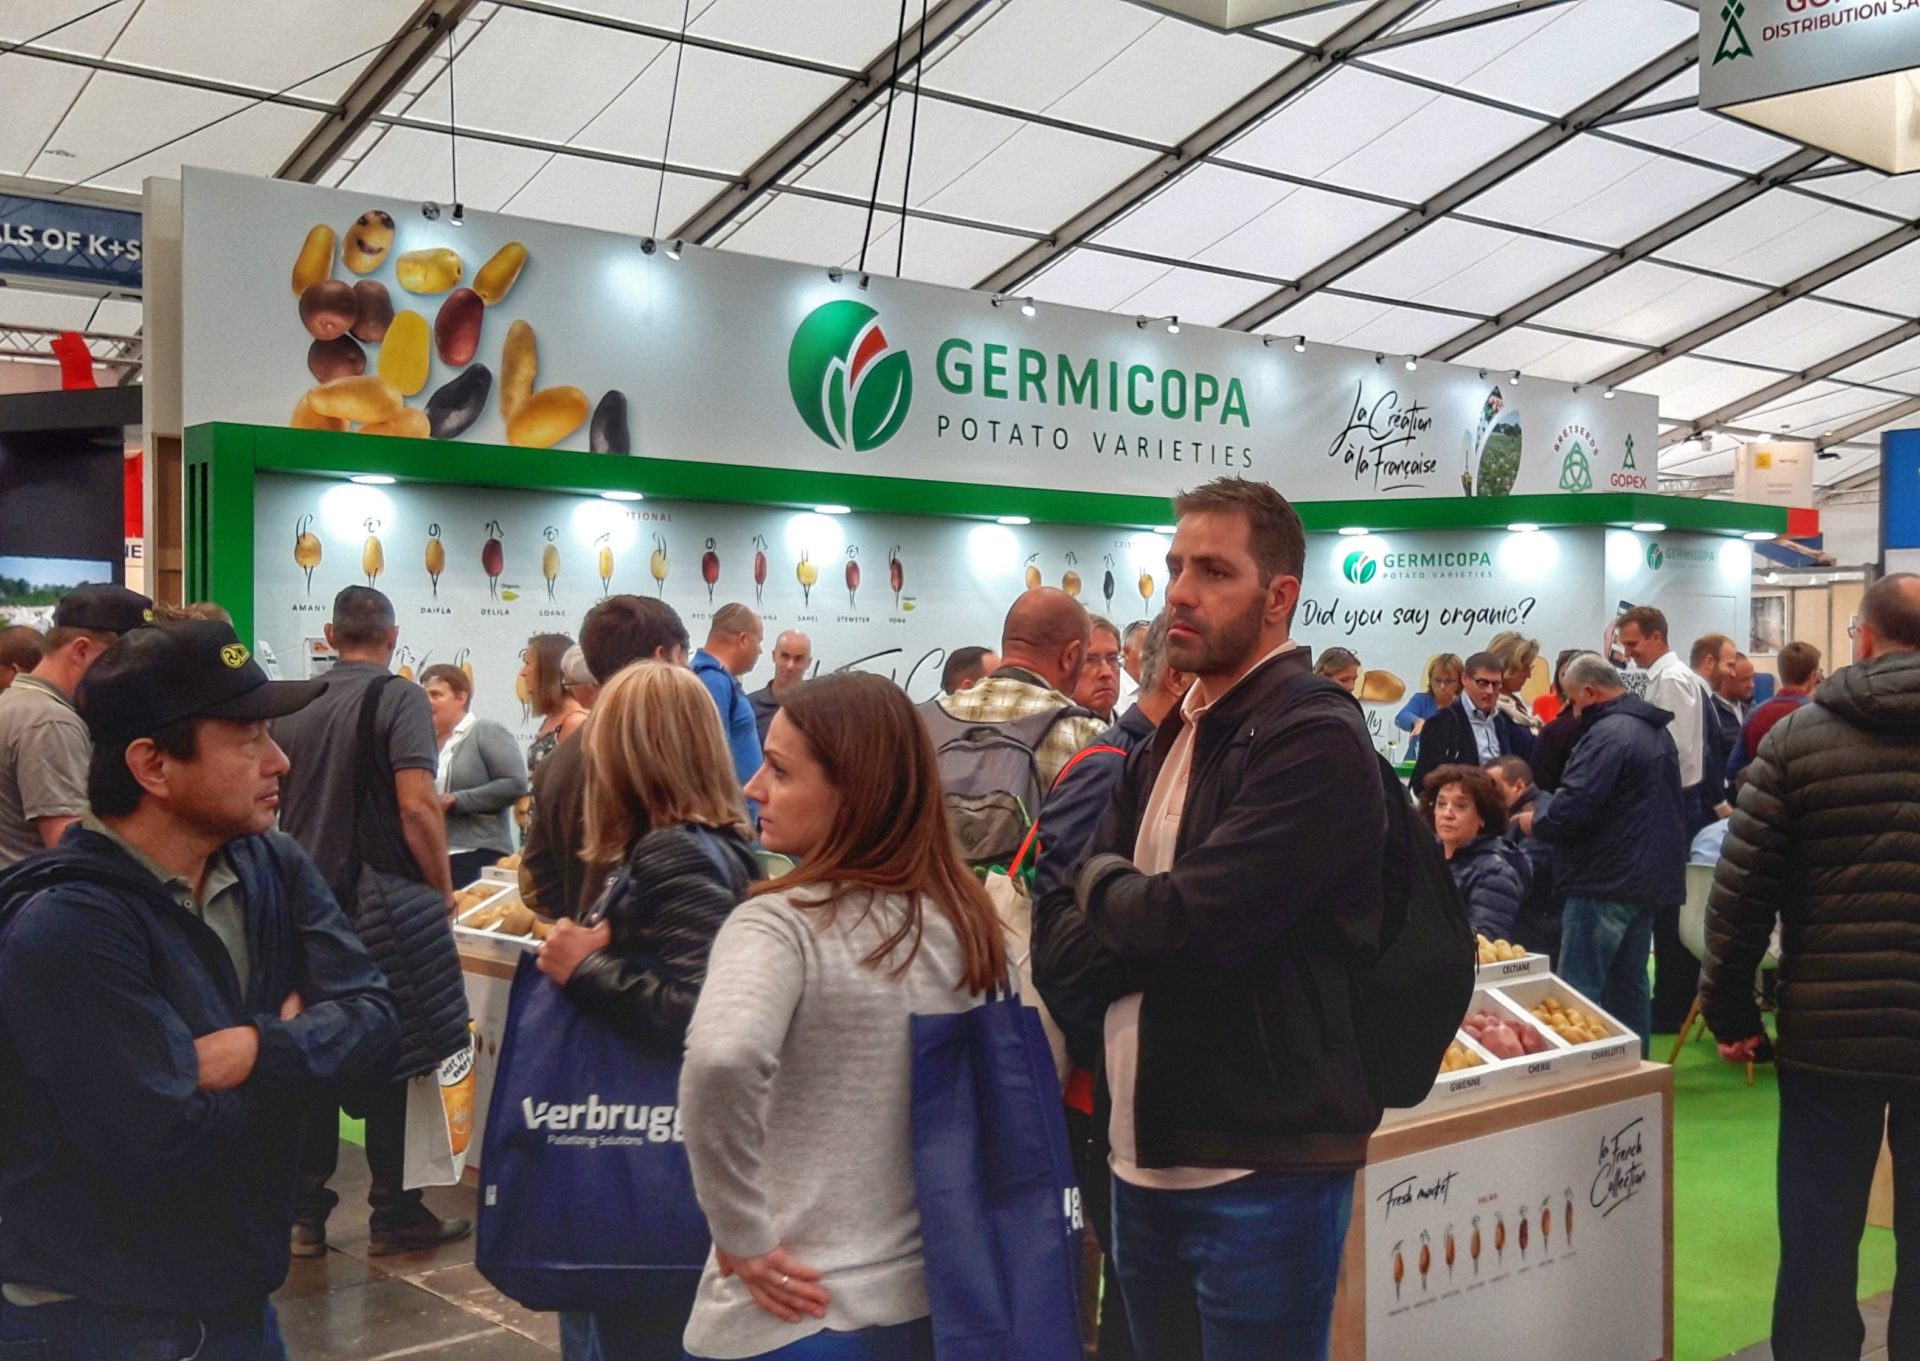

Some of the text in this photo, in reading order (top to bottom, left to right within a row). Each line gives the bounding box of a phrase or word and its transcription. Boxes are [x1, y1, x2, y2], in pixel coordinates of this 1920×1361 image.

[1762, 1, 1887, 41] DISTRIBUTION
[0, 223, 141, 261] LS OF K+S
[936, 338, 1250, 428] GERMICOPA
[1328, 379, 1432, 457] La Création
[938, 415, 1253, 468] POTATO VARIETIES
[1553, 425, 1599, 456] BRETSEEDS
[1355, 446, 1369, 481] la
[1368, 436, 1437, 491] Française
[1610, 473, 1648, 490] GOPEX
[1383, 552, 1491, 568] GERMICOPA
[1383, 570, 1493, 580] POTATO VARIETIES
[291, 604, 327, 612] AMANY
[420, 606, 452, 615] DAIFLA
[480, 608, 511, 616] DELILA
[1301, 597, 1536, 636] Did you say organic?
[1502, 962, 1530, 975] CELTIANE
[1528, 1062, 1551, 1074] CHERIE
[1591, 1045, 1626, 1060] CHARLOTTE
[1450, 1077, 1481, 1092] GWENNE
[1610, 1117, 1645, 1170] French
[1377, 1171, 1458, 1219] Fresh market
[1591, 1162, 1647, 1208] Collection
